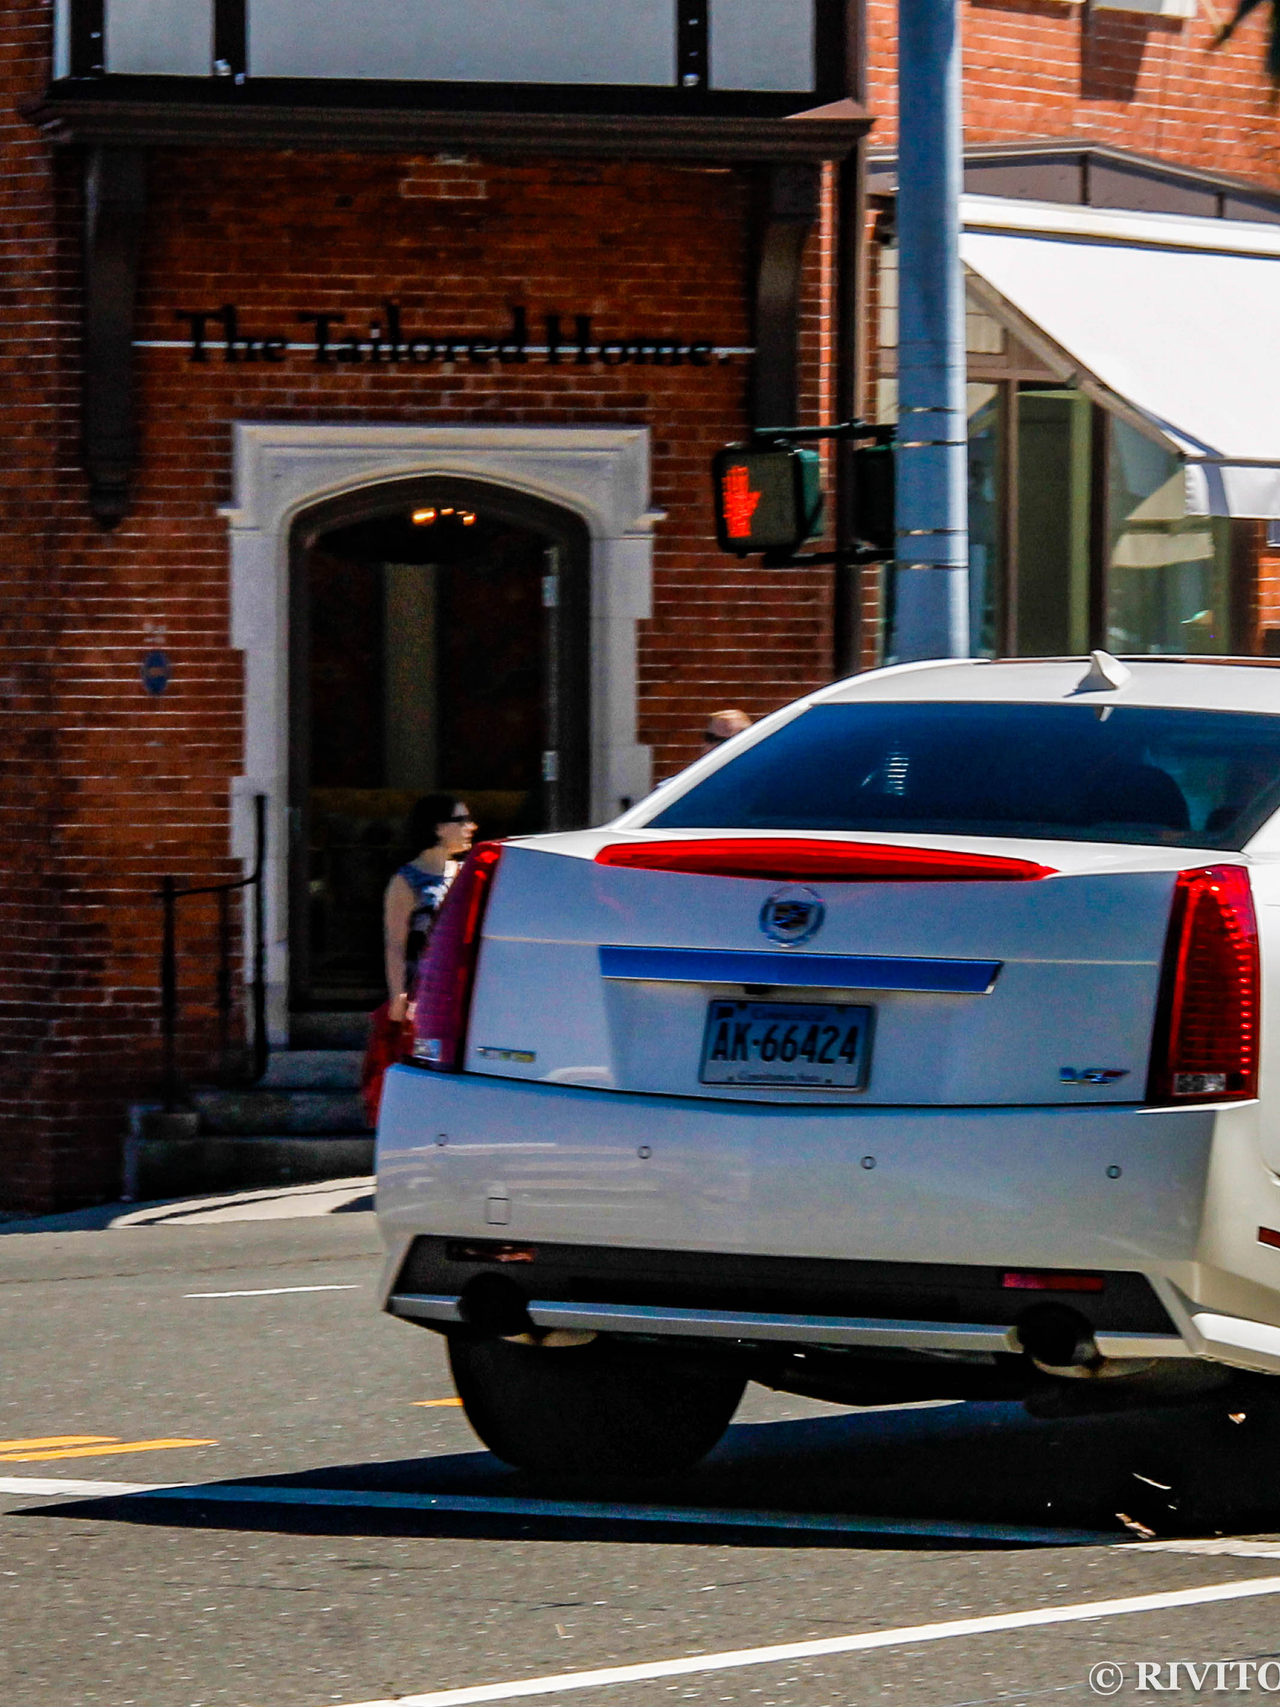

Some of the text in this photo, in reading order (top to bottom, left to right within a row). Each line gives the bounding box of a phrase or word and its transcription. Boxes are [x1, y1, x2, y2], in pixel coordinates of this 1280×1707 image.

[175, 303, 287, 364] The
[300, 302, 528, 366] Tailored
[709, 1021, 859, 1065] AK-66424
